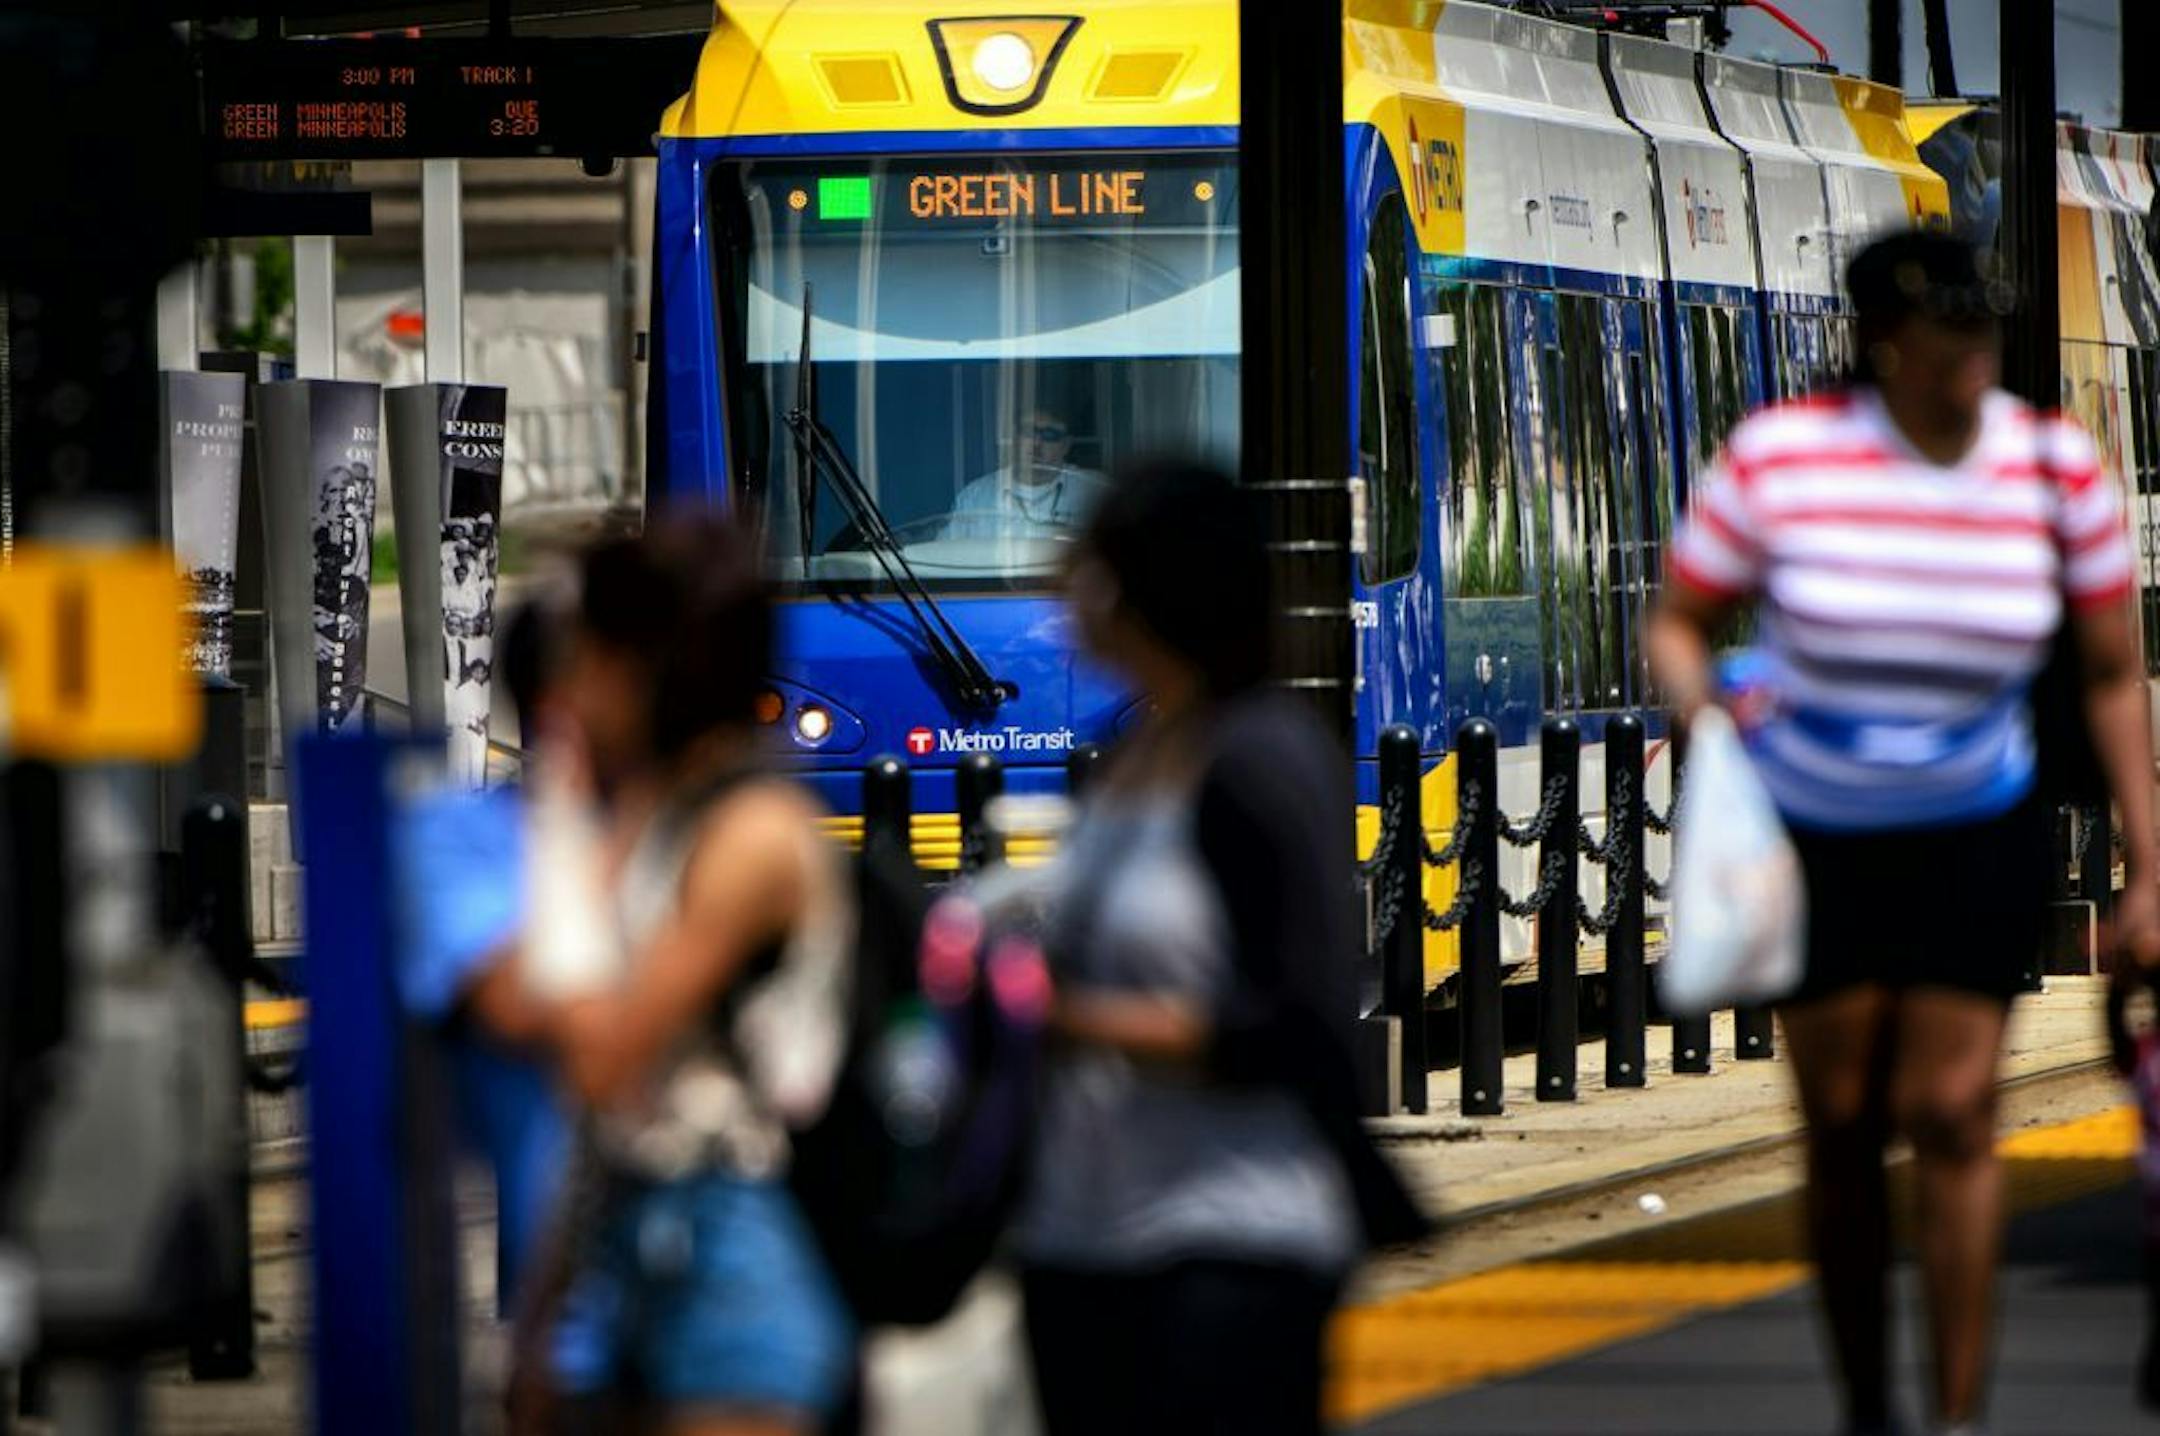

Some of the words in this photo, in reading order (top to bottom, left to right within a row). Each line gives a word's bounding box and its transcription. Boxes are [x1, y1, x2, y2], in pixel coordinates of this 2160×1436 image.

[343, 67, 380, 85] 3:00
[389, 66, 415, 85] PM
[460, 66, 516, 84] TRACK
[222, 103, 278, 121] GREEN
[296, 102, 406, 121] MINNEAPOLIS
[223, 121, 278, 139] GREEN
[296, 120, 406, 138] MINNEAPOLIS
[489, 119, 539, 135] 3:20
[910, 173, 1034, 218] GREEN
[1051, 171, 1145, 215] LINE
